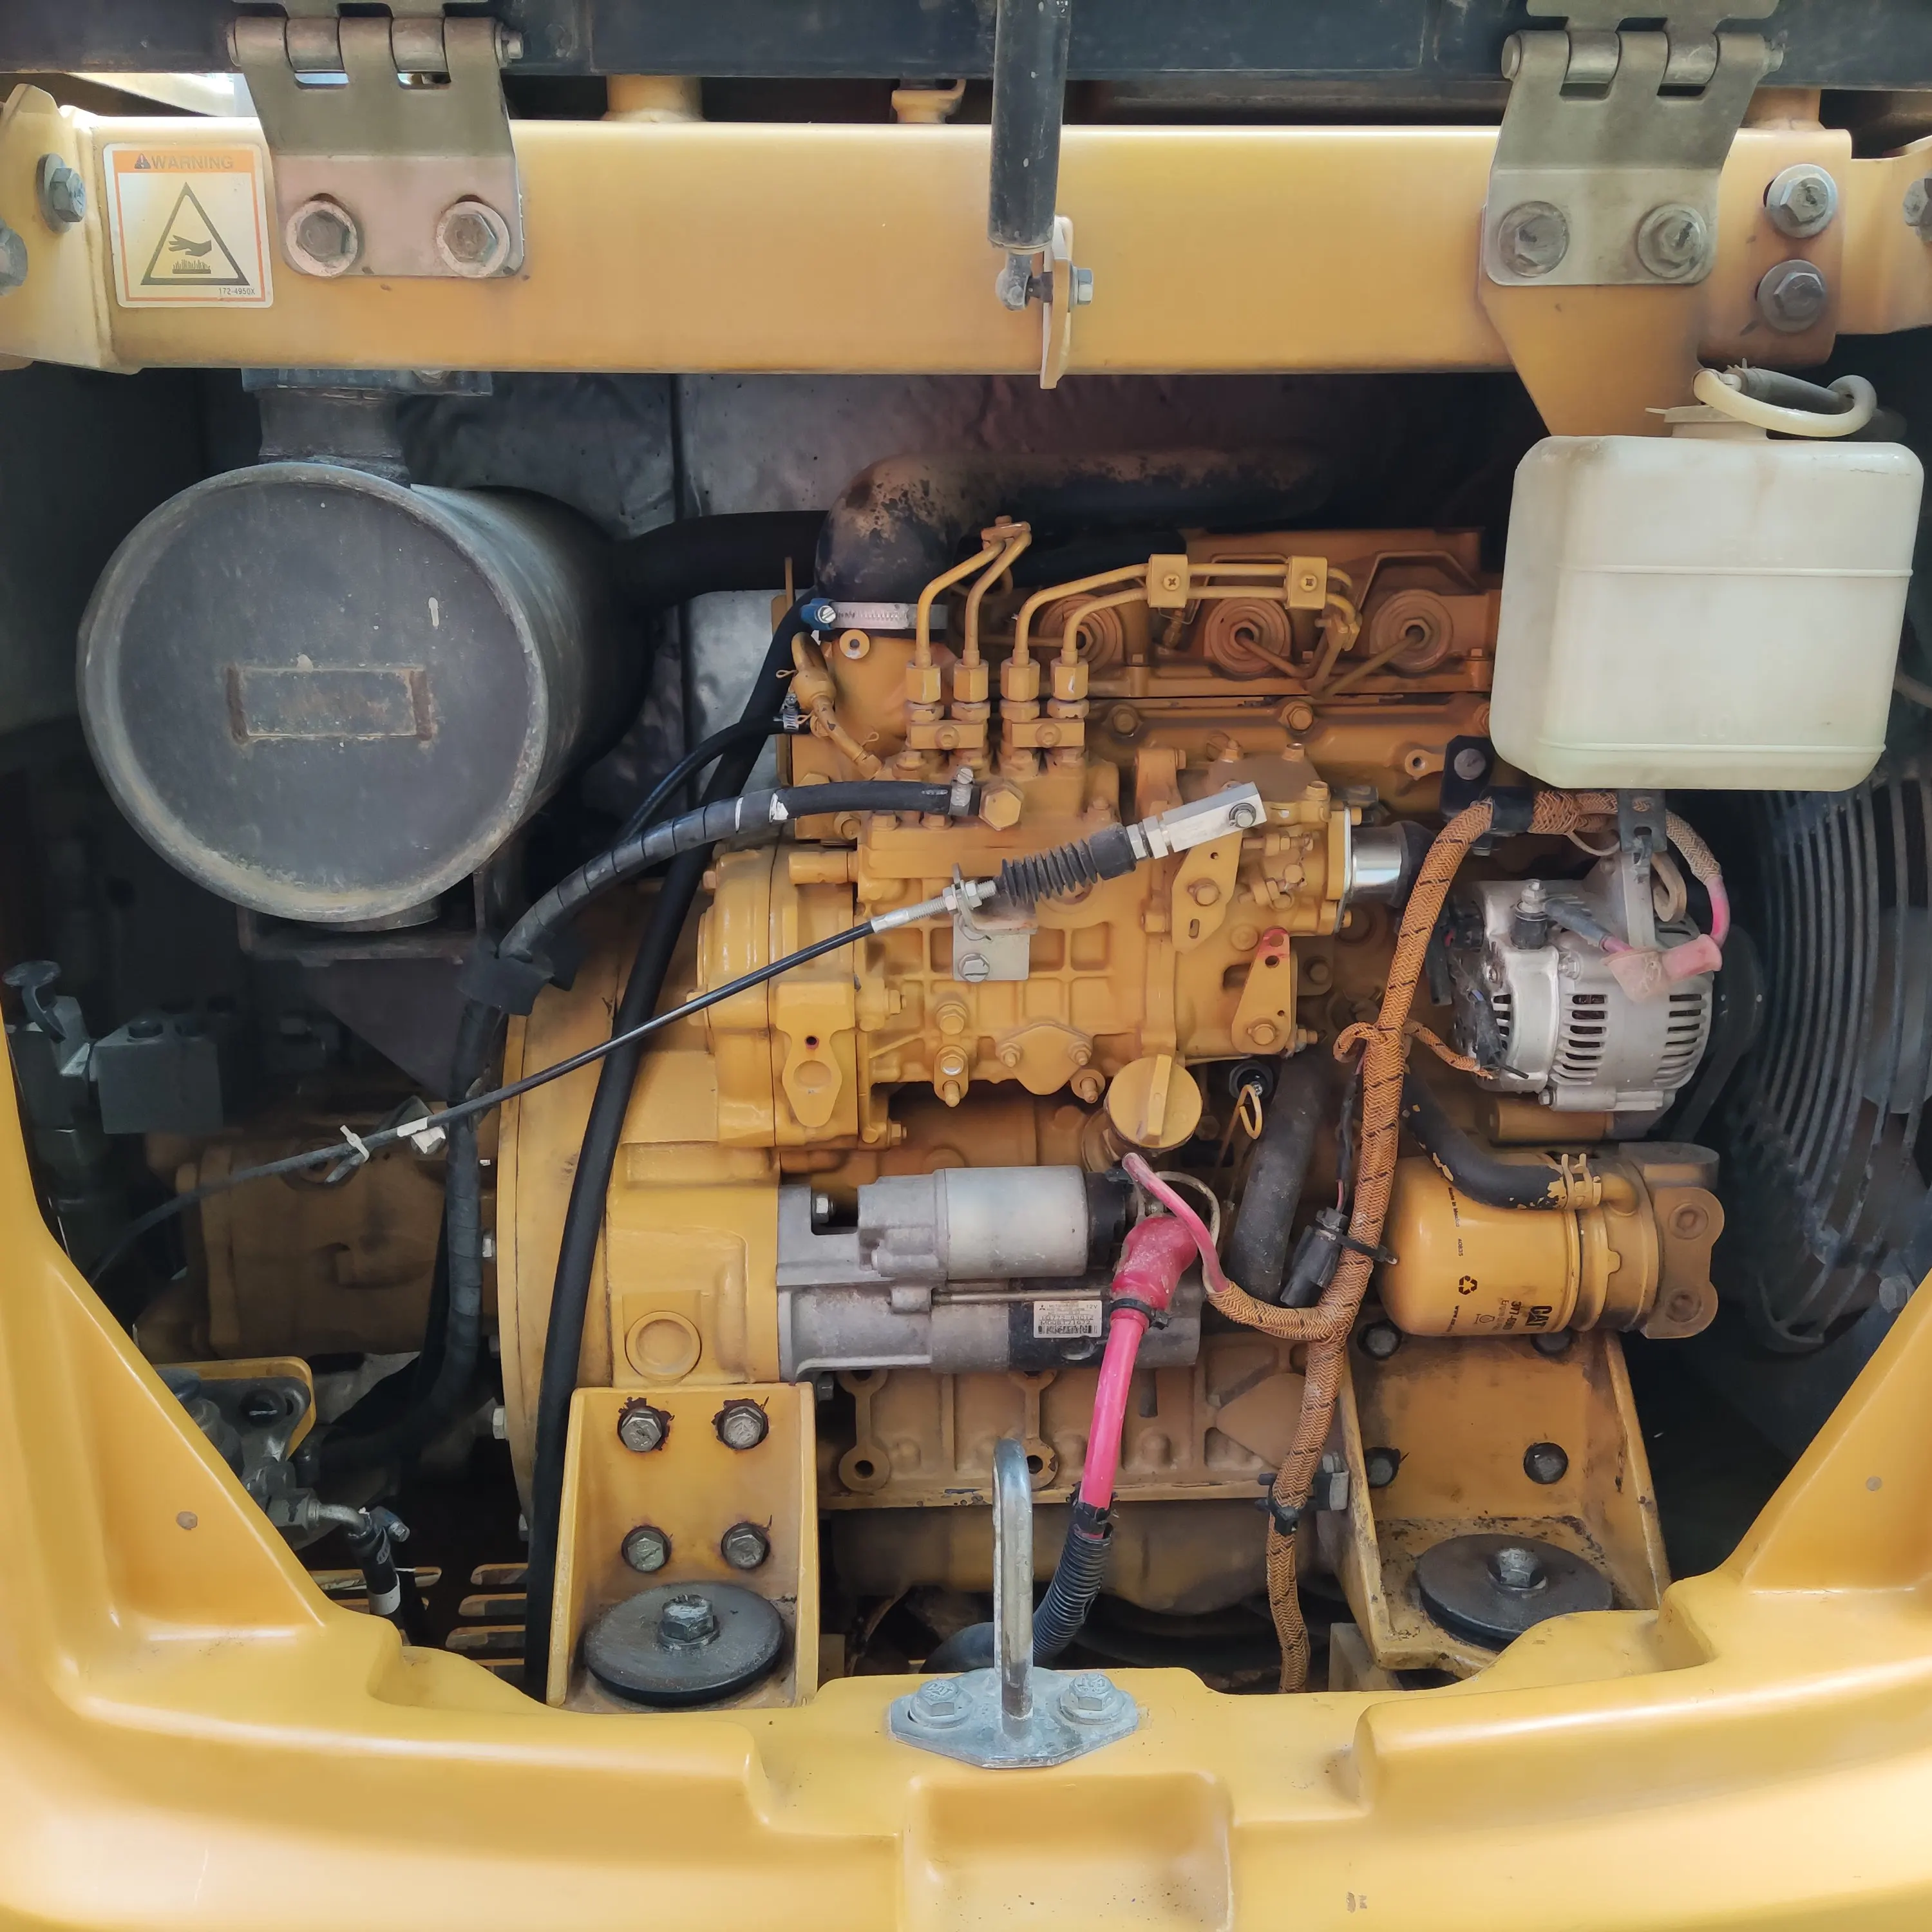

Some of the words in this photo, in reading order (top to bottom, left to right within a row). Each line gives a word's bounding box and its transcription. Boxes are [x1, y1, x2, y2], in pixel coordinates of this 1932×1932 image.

[151, 155, 233, 169] WARNING
[219, 287, 255, 296] 172-4950X
[1525, 1305, 1553, 1327] CAT
[926, 1683, 953, 1696] CAT
